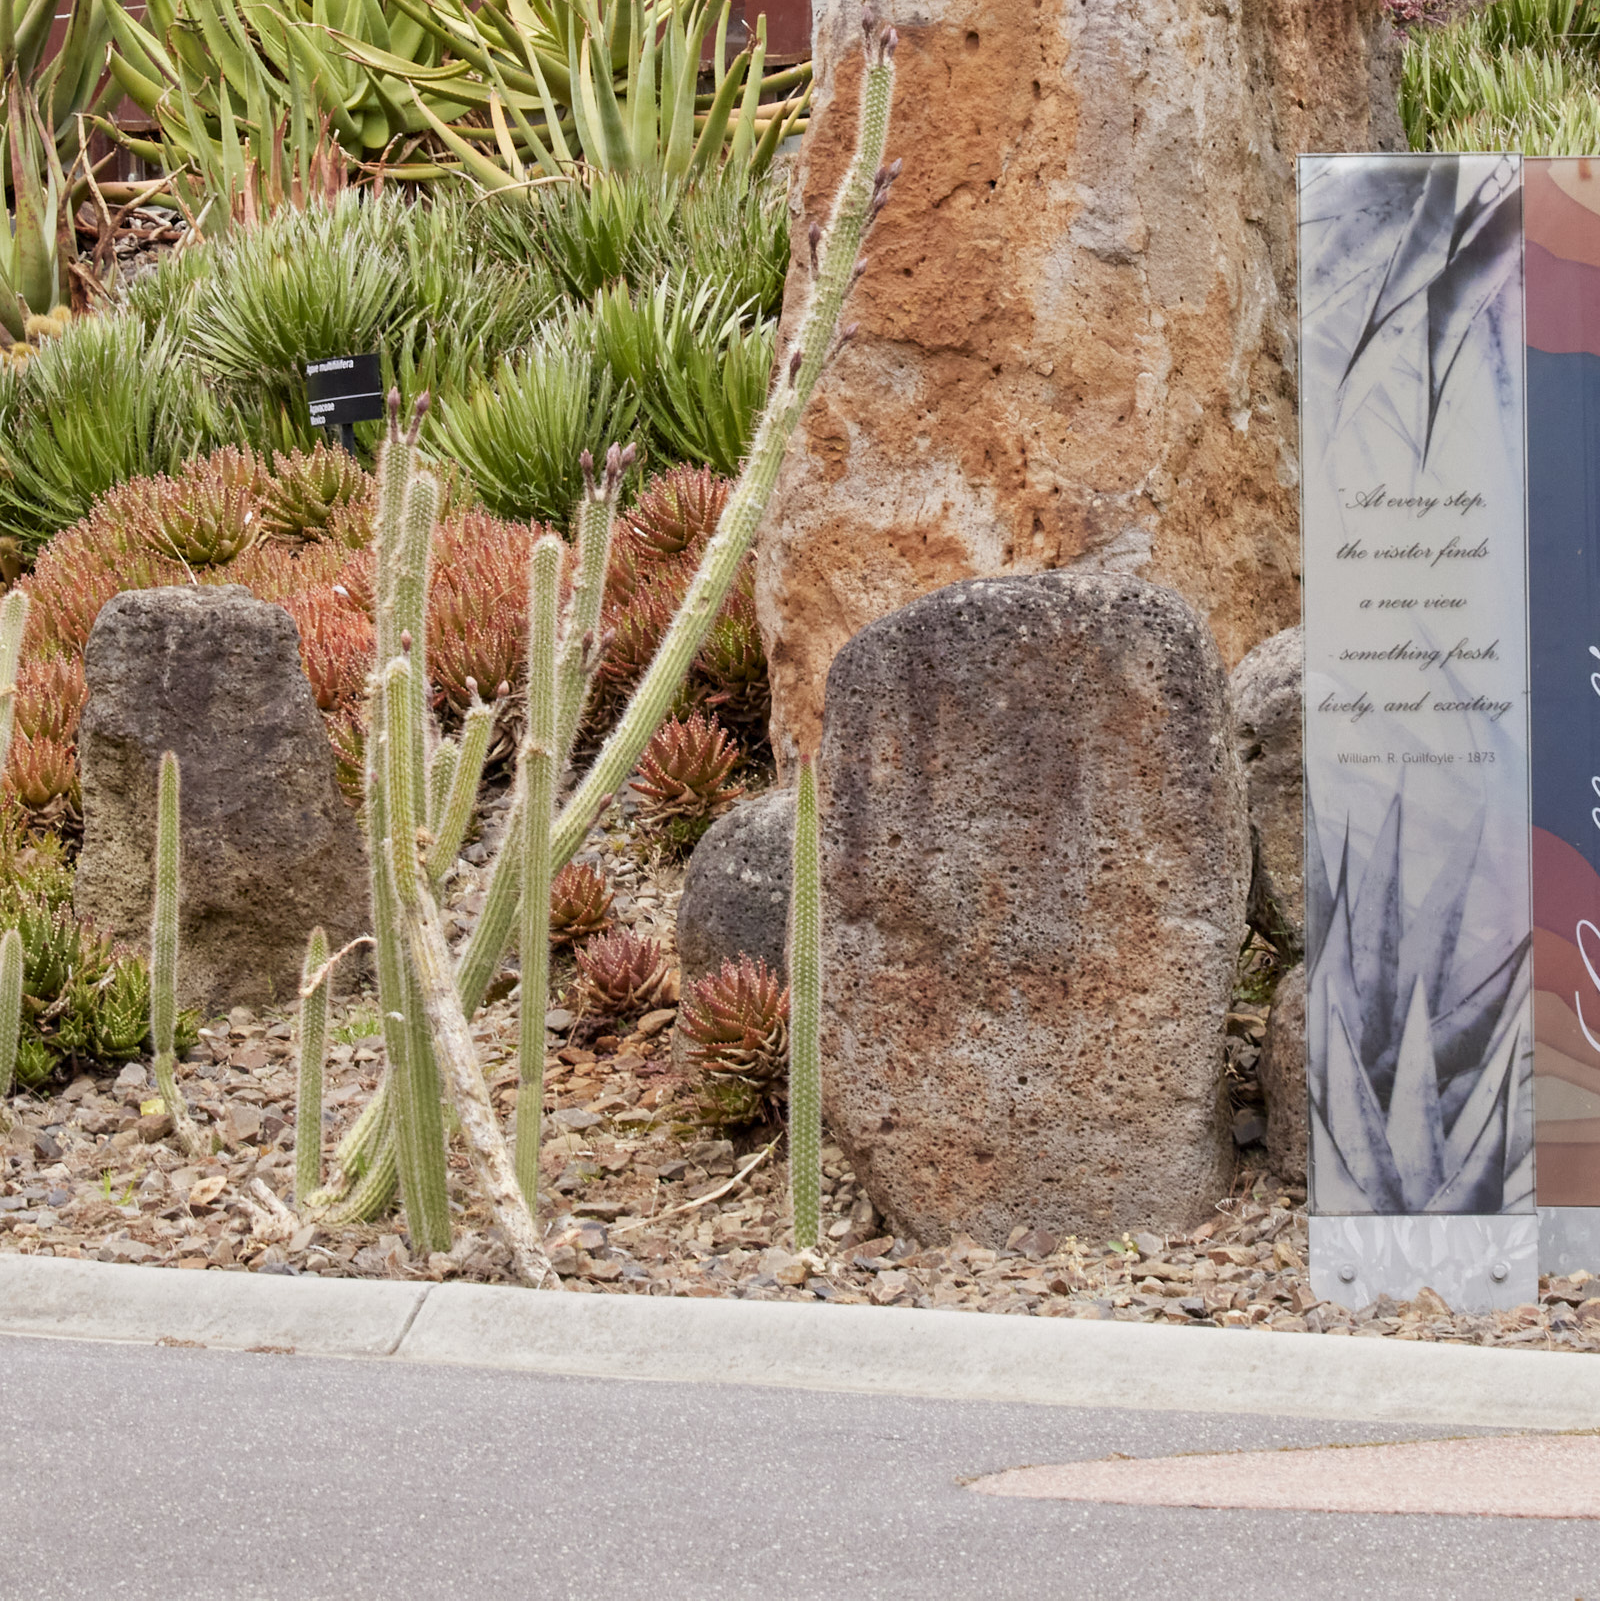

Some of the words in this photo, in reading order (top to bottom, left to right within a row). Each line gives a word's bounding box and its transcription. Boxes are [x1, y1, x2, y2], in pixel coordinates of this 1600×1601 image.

[1388, 496, 1440, 518] every
[1336, 539, 1368, 559] the
[1374, 542, 1433, 559] visitor
[1431, 537, 1489, 567] finds
[1359, 598, 1371, 608] a
[1378, 598, 1418, 608] new
[1424, 594, 1468, 608] view
[1339, 640, 1441, 671] something
[1384, 692, 1429, 713] and
[1388, 753, 1398, 763] R.
[1402, 752, 1454, 764] Guilfoyle
[1468, 752, 1495, 763] 1873
